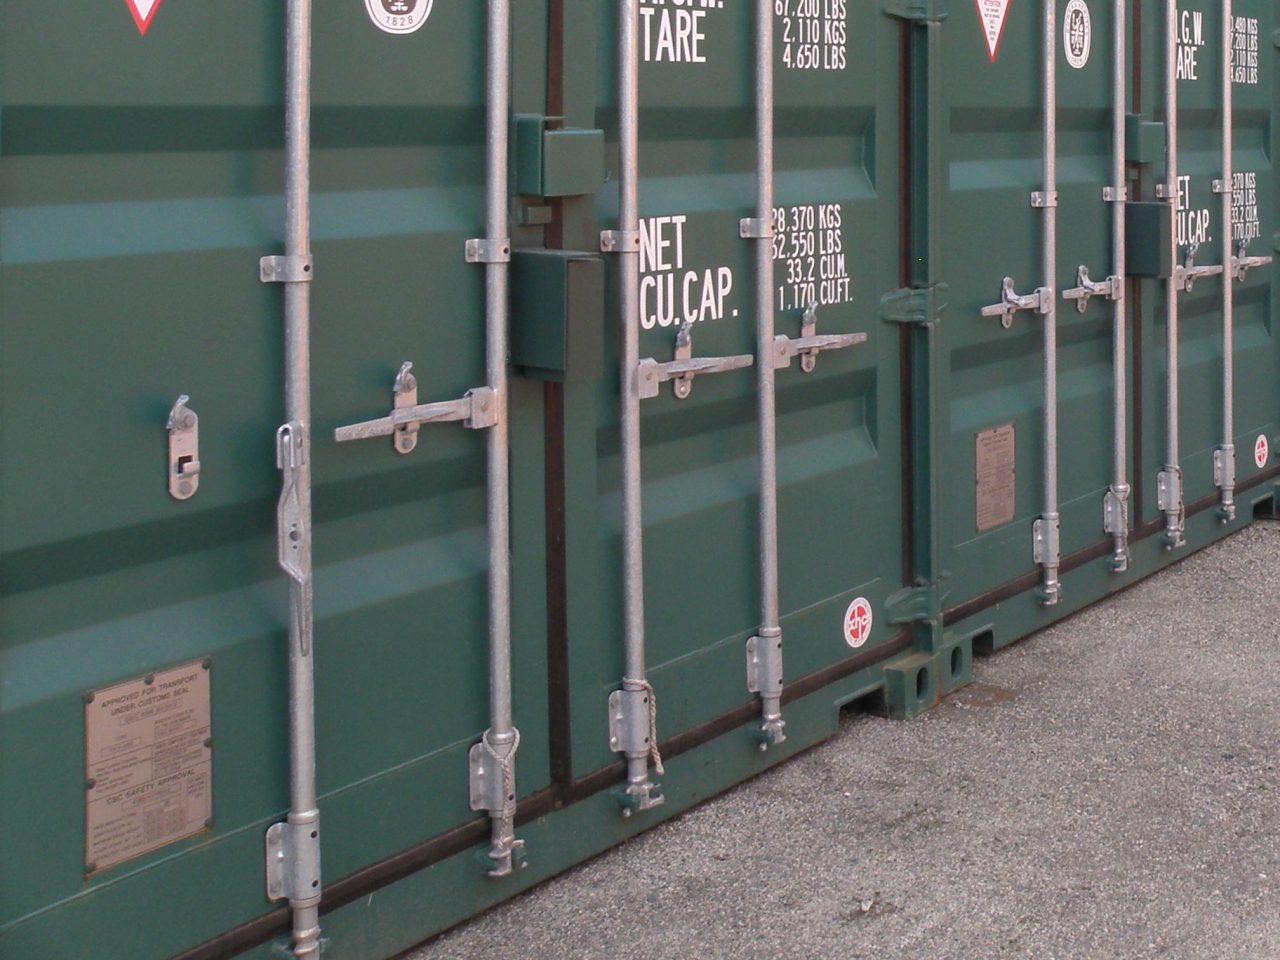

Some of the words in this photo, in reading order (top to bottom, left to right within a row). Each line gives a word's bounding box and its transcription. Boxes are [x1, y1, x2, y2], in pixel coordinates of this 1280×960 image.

[385, 16, 413, 26] 1828
[640, 7, 706, 62] TARE
[783, 17, 820, 43] 2,110
[824, 19, 846, 44] KGS
[783, 43, 820, 69] 4,650
[824, 45, 846, 70] LBS
[1176, 45, 1197, 80] ARE
[1176, 176, 1190, 210] ET
[819, 204, 841, 229] KGS
[1176, 209, 1211, 245] U.CAP.
[639, 215, 686, 272] NET
[819, 229, 841, 254] LBS
[787, 257, 815, 283] 33.2
[779, 282, 815, 311] 1,170
